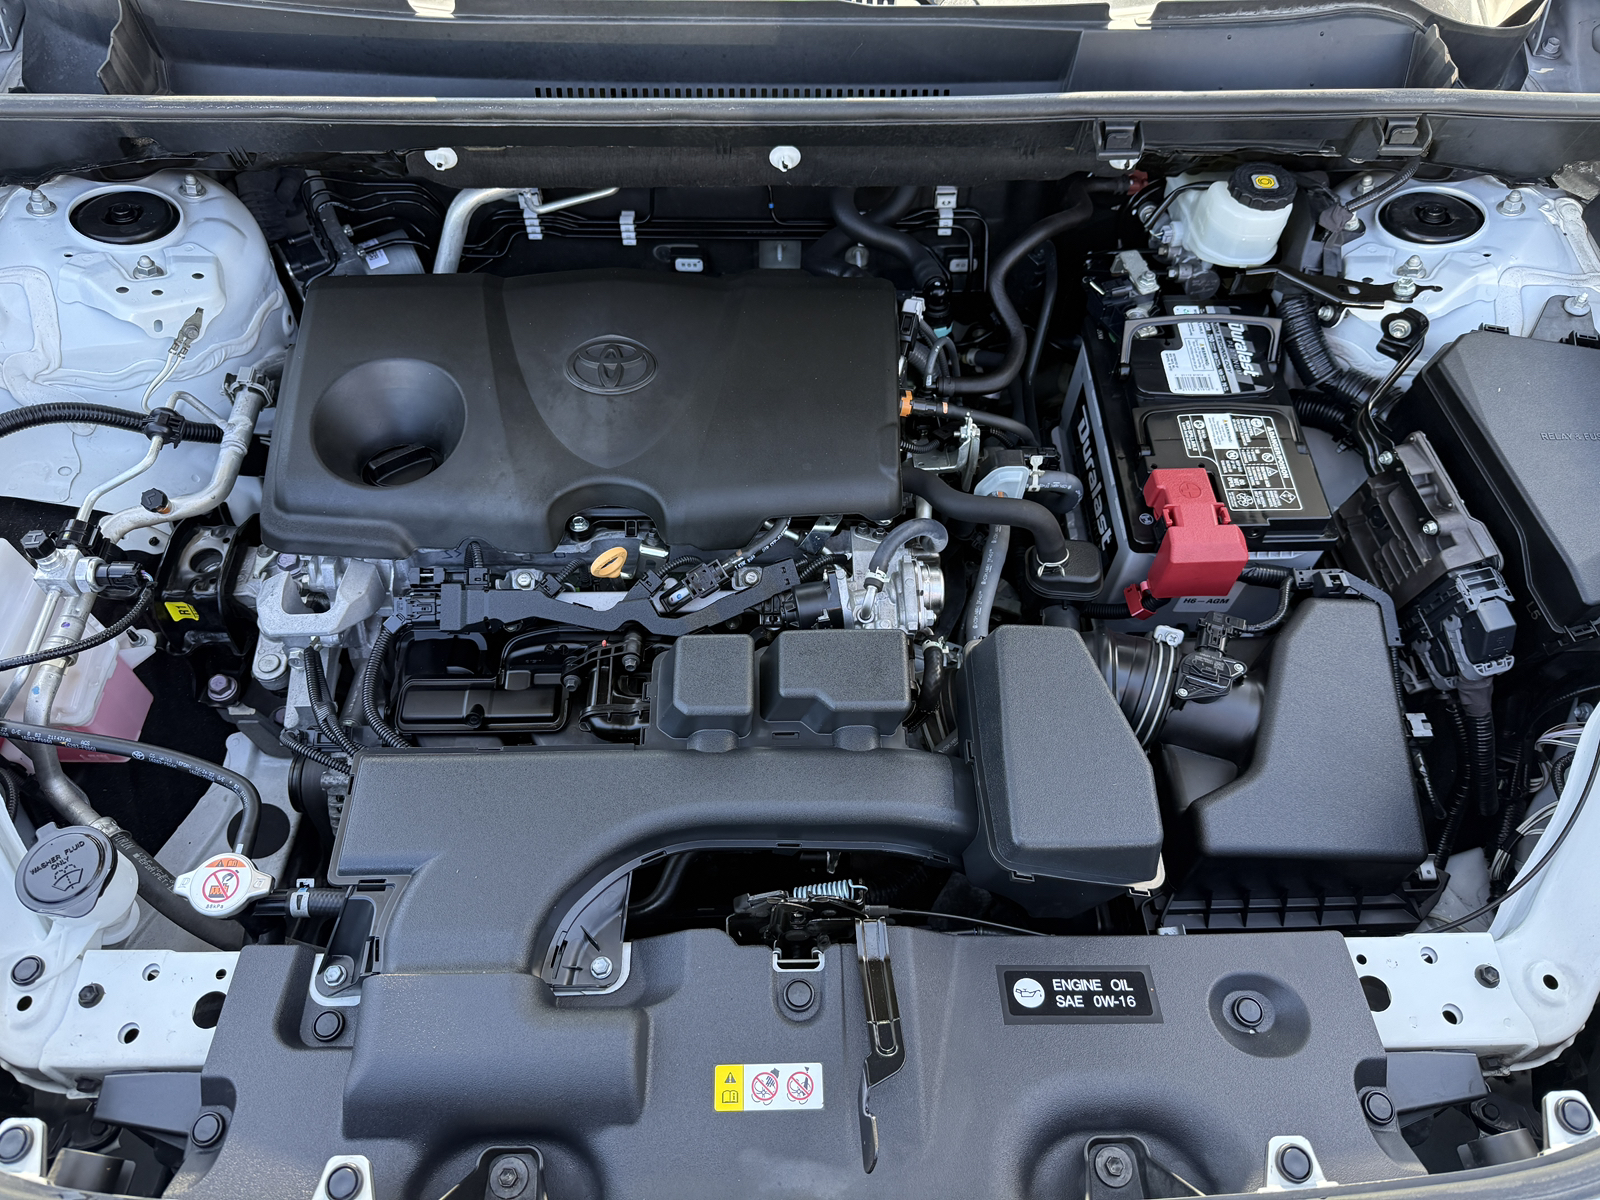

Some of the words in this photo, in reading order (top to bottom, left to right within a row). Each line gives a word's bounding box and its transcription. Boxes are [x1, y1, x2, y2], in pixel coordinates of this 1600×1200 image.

[1218, 334, 1232, 373] TECHNOLOGY
[1226, 340, 1243, 375] PLATINUM
[1228, 322, 1260, 377] Duralast
[1540, 432, 1572, 441] RELAY
[1077, 405, 1112, 551] Duralast
[1526, 601, 1541, 620] L5
[29, 854, 61, 875] WASHER
[64, 841, 85, 855] FLUID
[51, 856, 70, 870] ONLY
[1052, 978, 1102, 991] ENGINE
[1110, 978, 1134, 991] OIL
[1056, 995, 1085, 1008] SAE
[1093, 995, 1137, 1008] 0W-16
